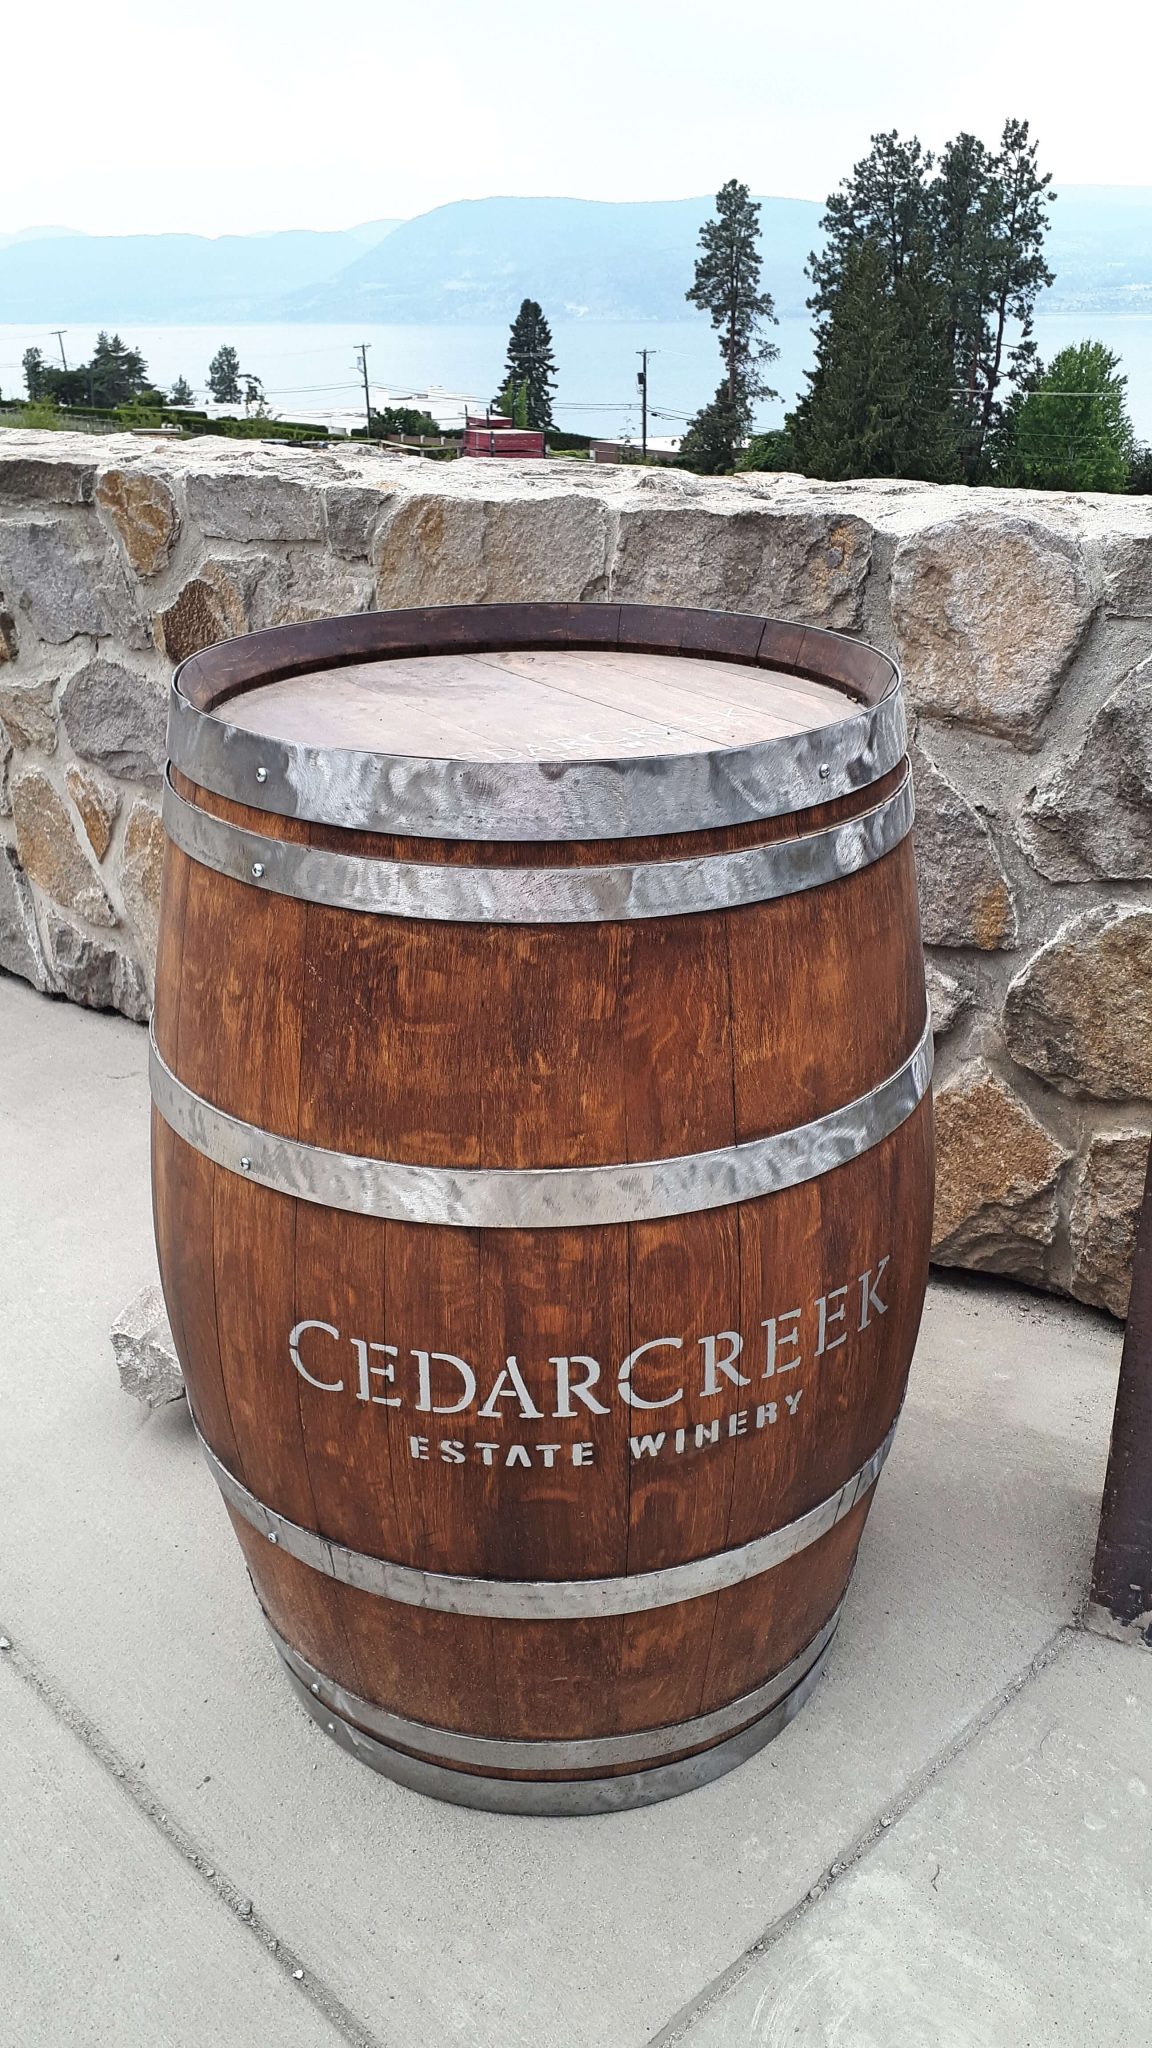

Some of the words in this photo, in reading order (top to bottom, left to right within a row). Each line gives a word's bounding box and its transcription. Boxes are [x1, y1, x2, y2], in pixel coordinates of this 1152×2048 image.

[451, 706, 756, 761] EDARCREEK
[288, 1254, 891, 1419] CEDARCREEK
[409, 1435, 595, 1468] ESTATE
[629, 1389, 804, 1460] WINERY
